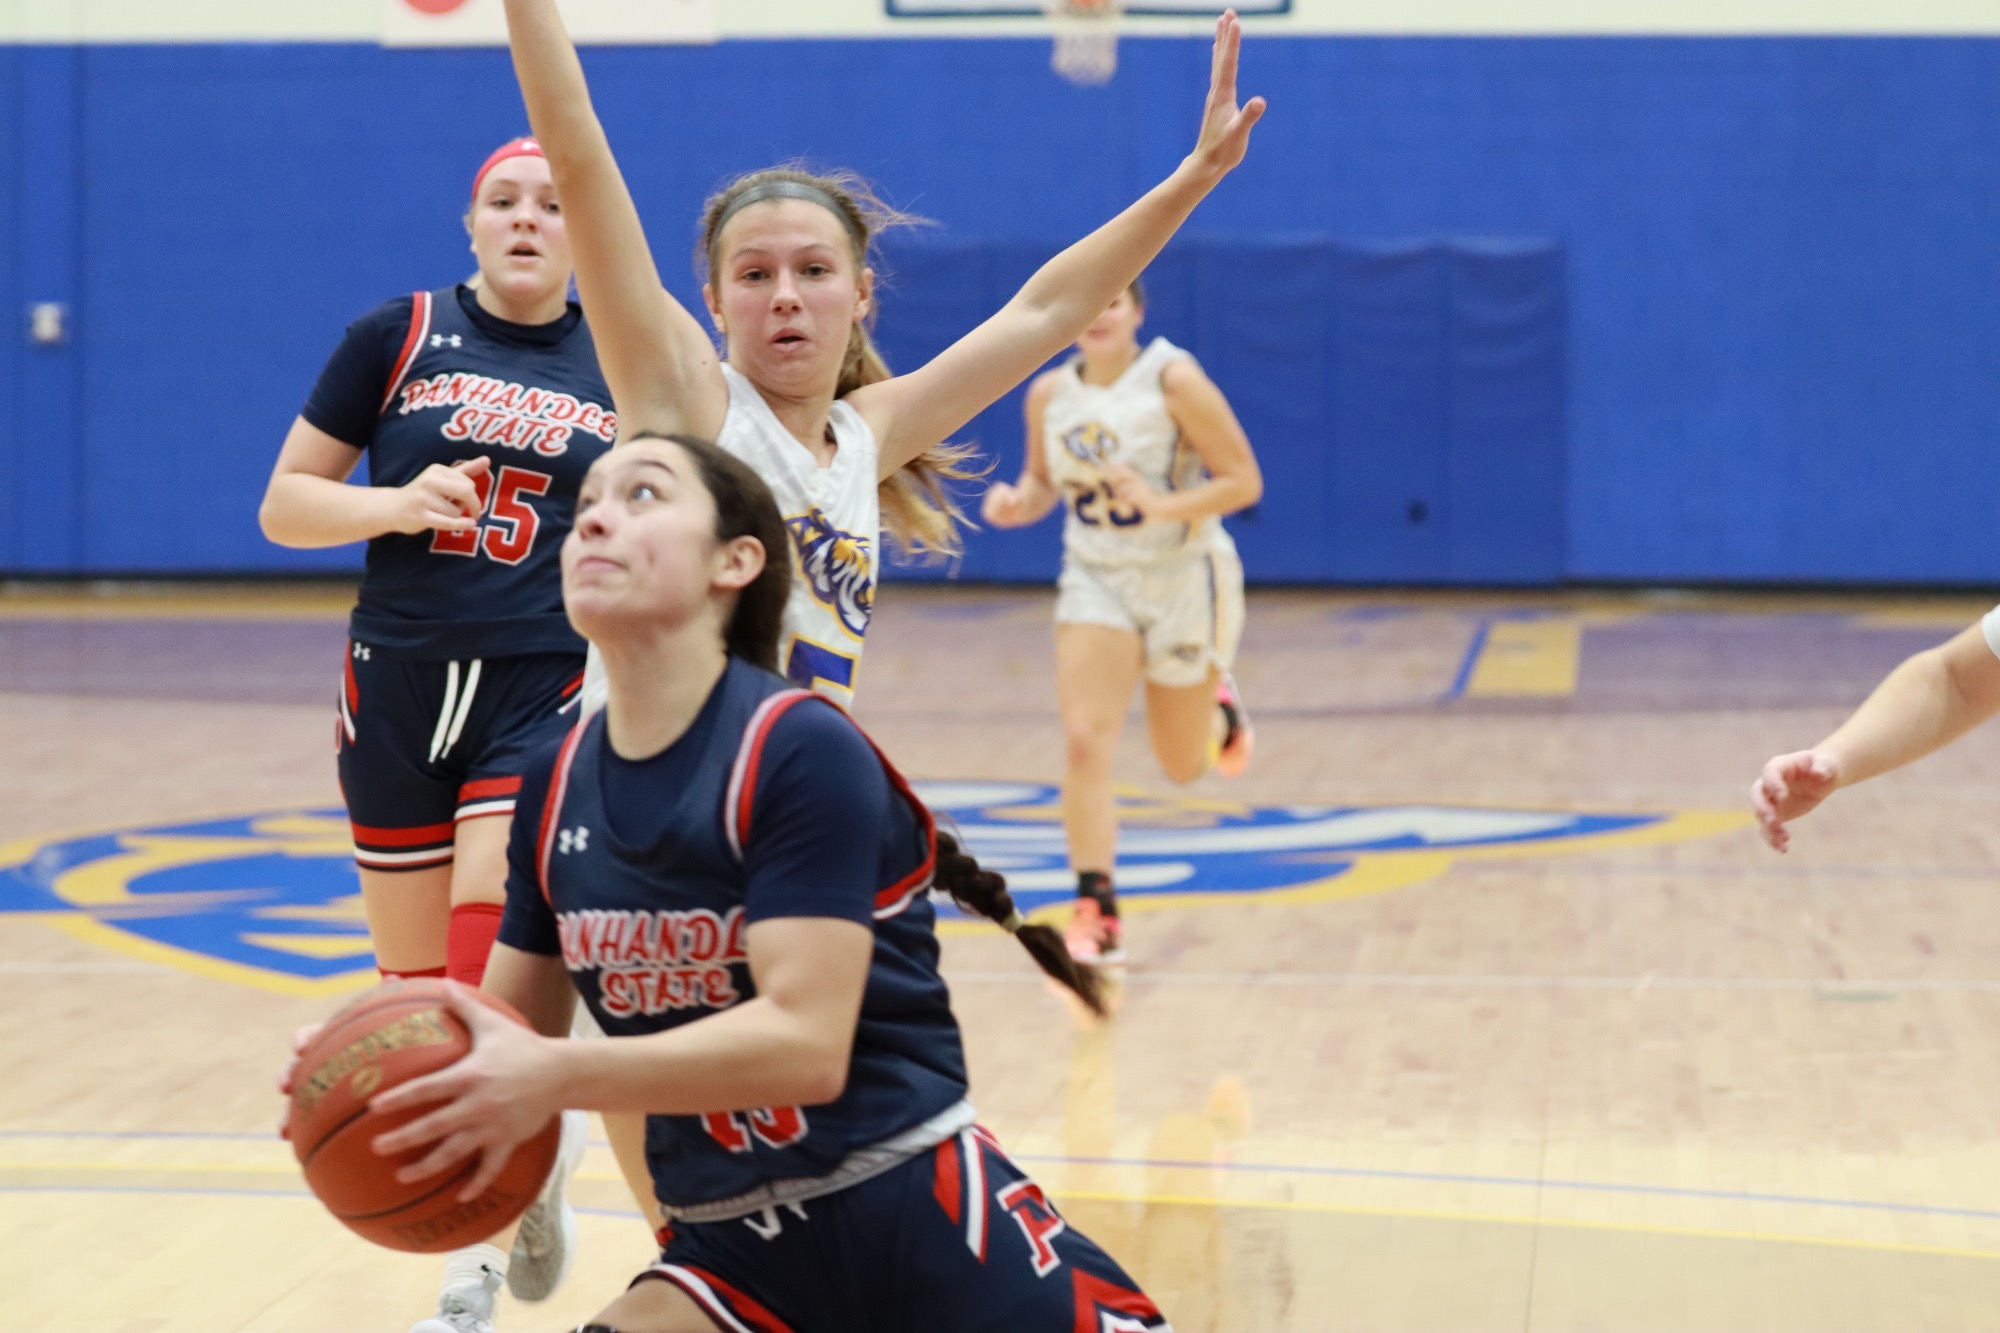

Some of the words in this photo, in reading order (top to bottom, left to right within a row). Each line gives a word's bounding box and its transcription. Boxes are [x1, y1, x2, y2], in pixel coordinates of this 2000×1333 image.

[399, 372, 618, 442] PANHANDLE
[441, 404, 572, 457] STATE
[556, 905, 748, 971] ANHANDL
[599, 965, 740, 1018] STATE
[996, 1177, 1065, 1279] P
